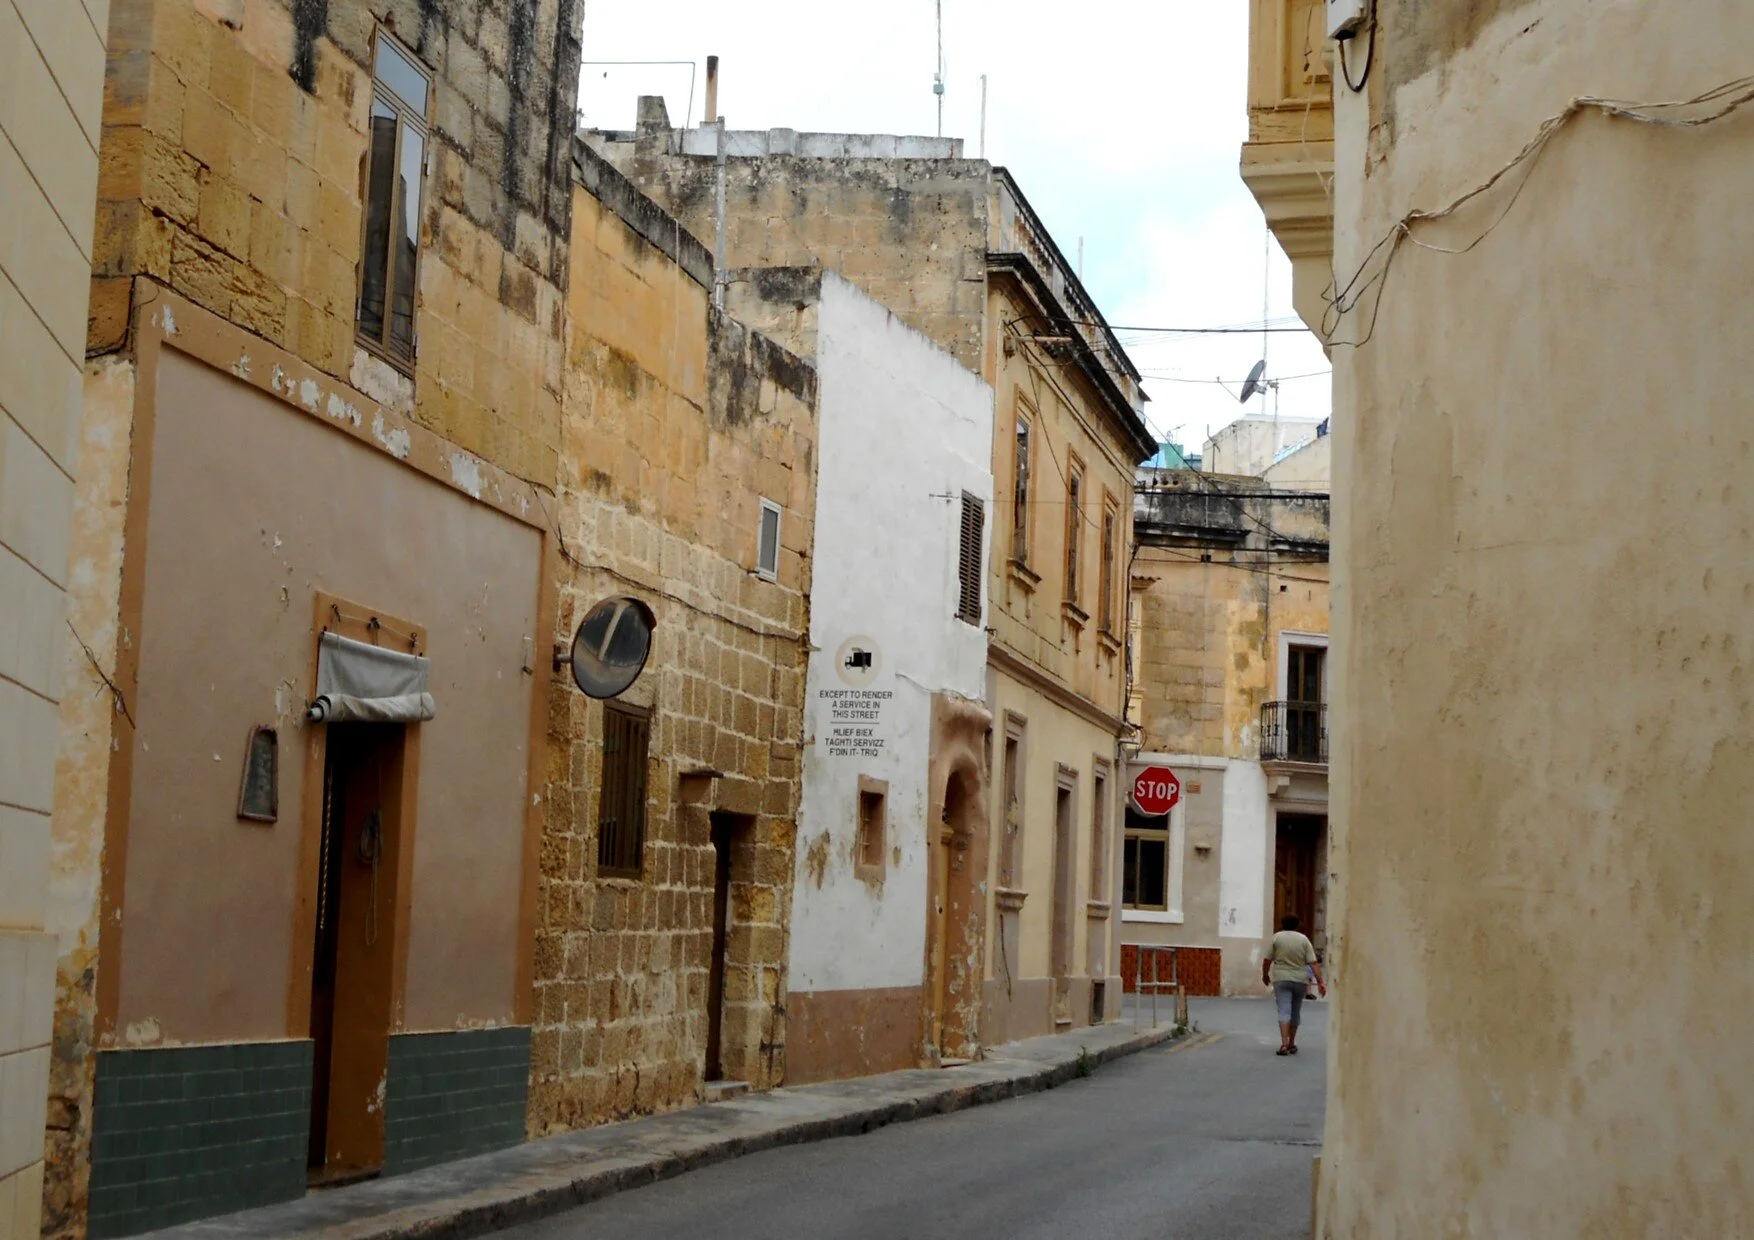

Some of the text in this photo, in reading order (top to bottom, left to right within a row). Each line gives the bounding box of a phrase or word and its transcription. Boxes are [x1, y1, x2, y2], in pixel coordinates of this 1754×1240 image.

[819, 690, 893, 699] EXCEPT TO RENDER
[832, 700, 880, 709] A SERVICE IN
[832, 710, 880, 719] THIS STREET
[855, 728, 873, 737] BIEX
[853, 738, 885, 748] SERVIZZ
[1136, 780, 1177, 800] STOP
